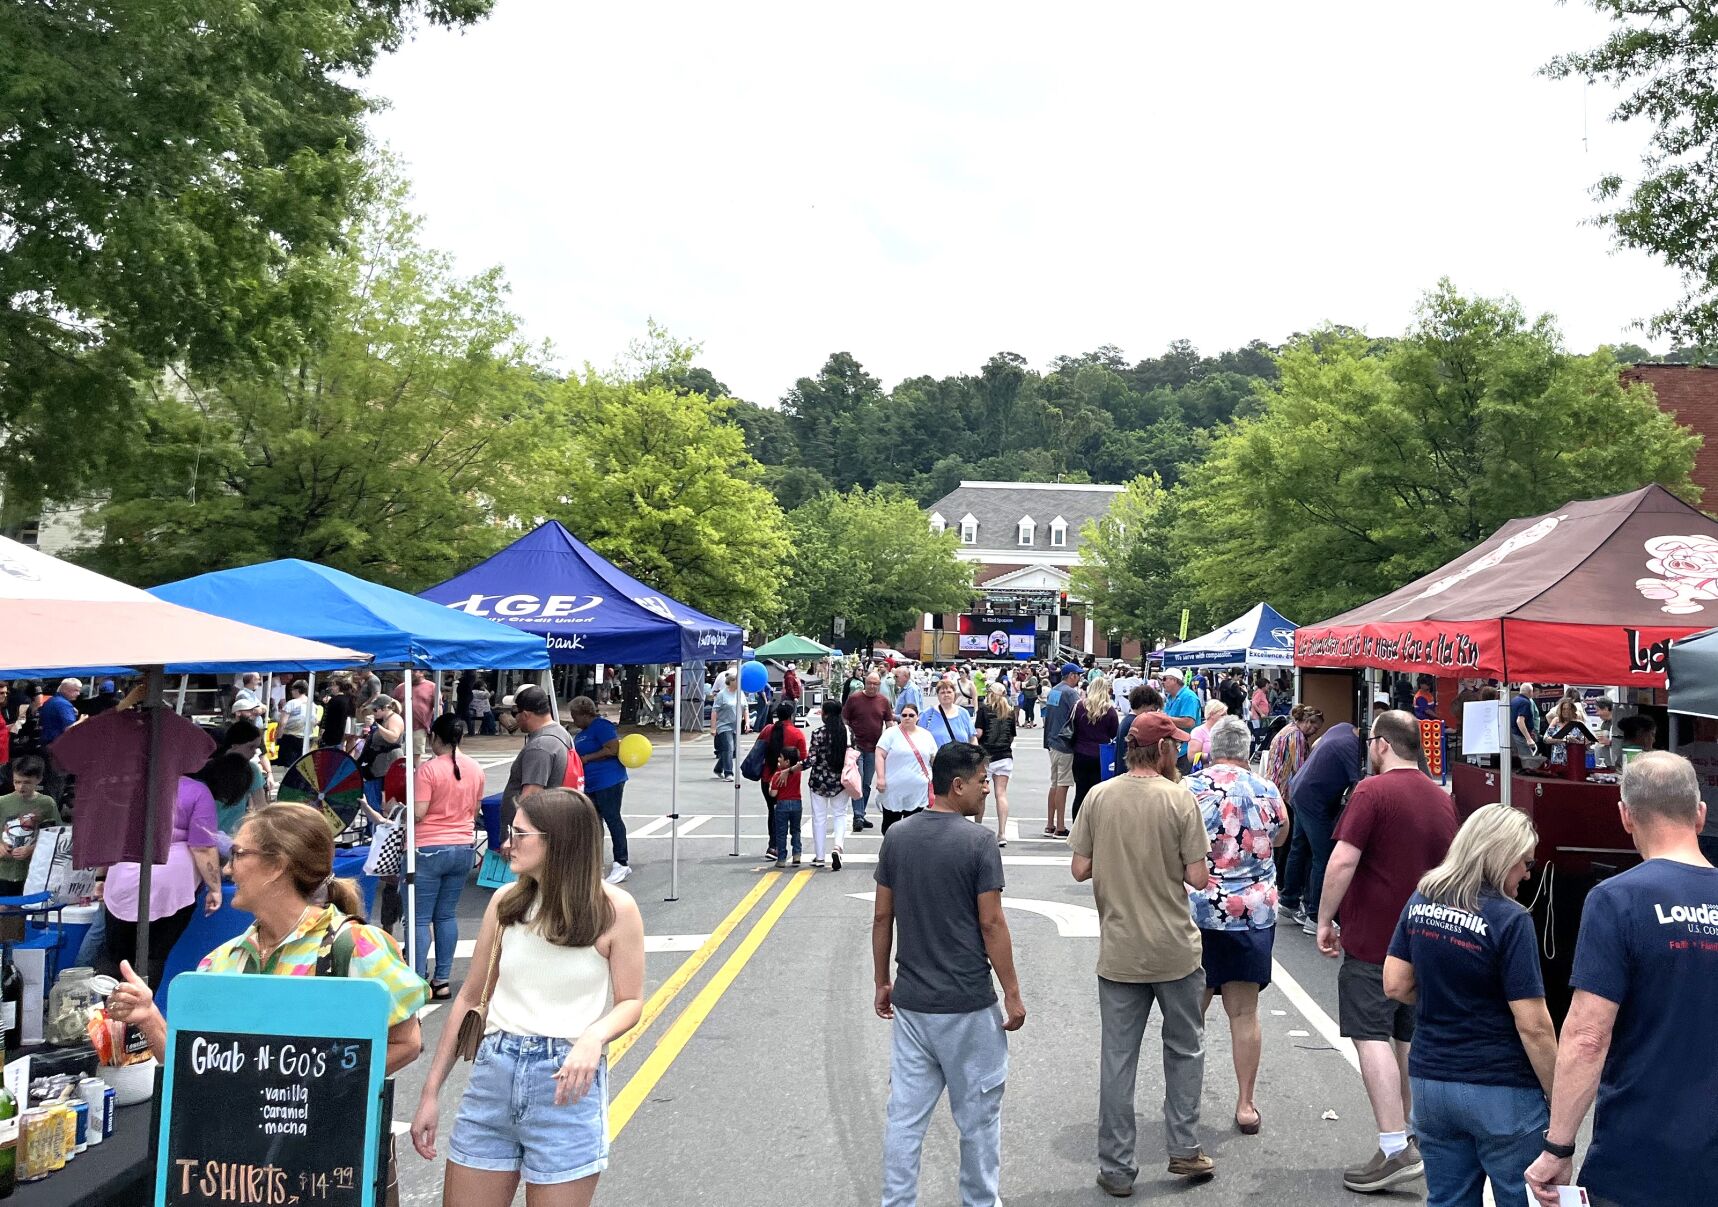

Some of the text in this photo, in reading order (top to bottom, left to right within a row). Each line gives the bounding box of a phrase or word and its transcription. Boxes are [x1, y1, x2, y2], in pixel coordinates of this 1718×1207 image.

[462, 594, 577, 617] LGE
[1425, 917, 1462, 934] CONGRESS
[1687, 923, 1702, 934] U.S.
[265, 1084, 309, 1102] vanilla
[263, 1104, 309, 1120] caramel
[264, 1121, 307, 1137] mocha
